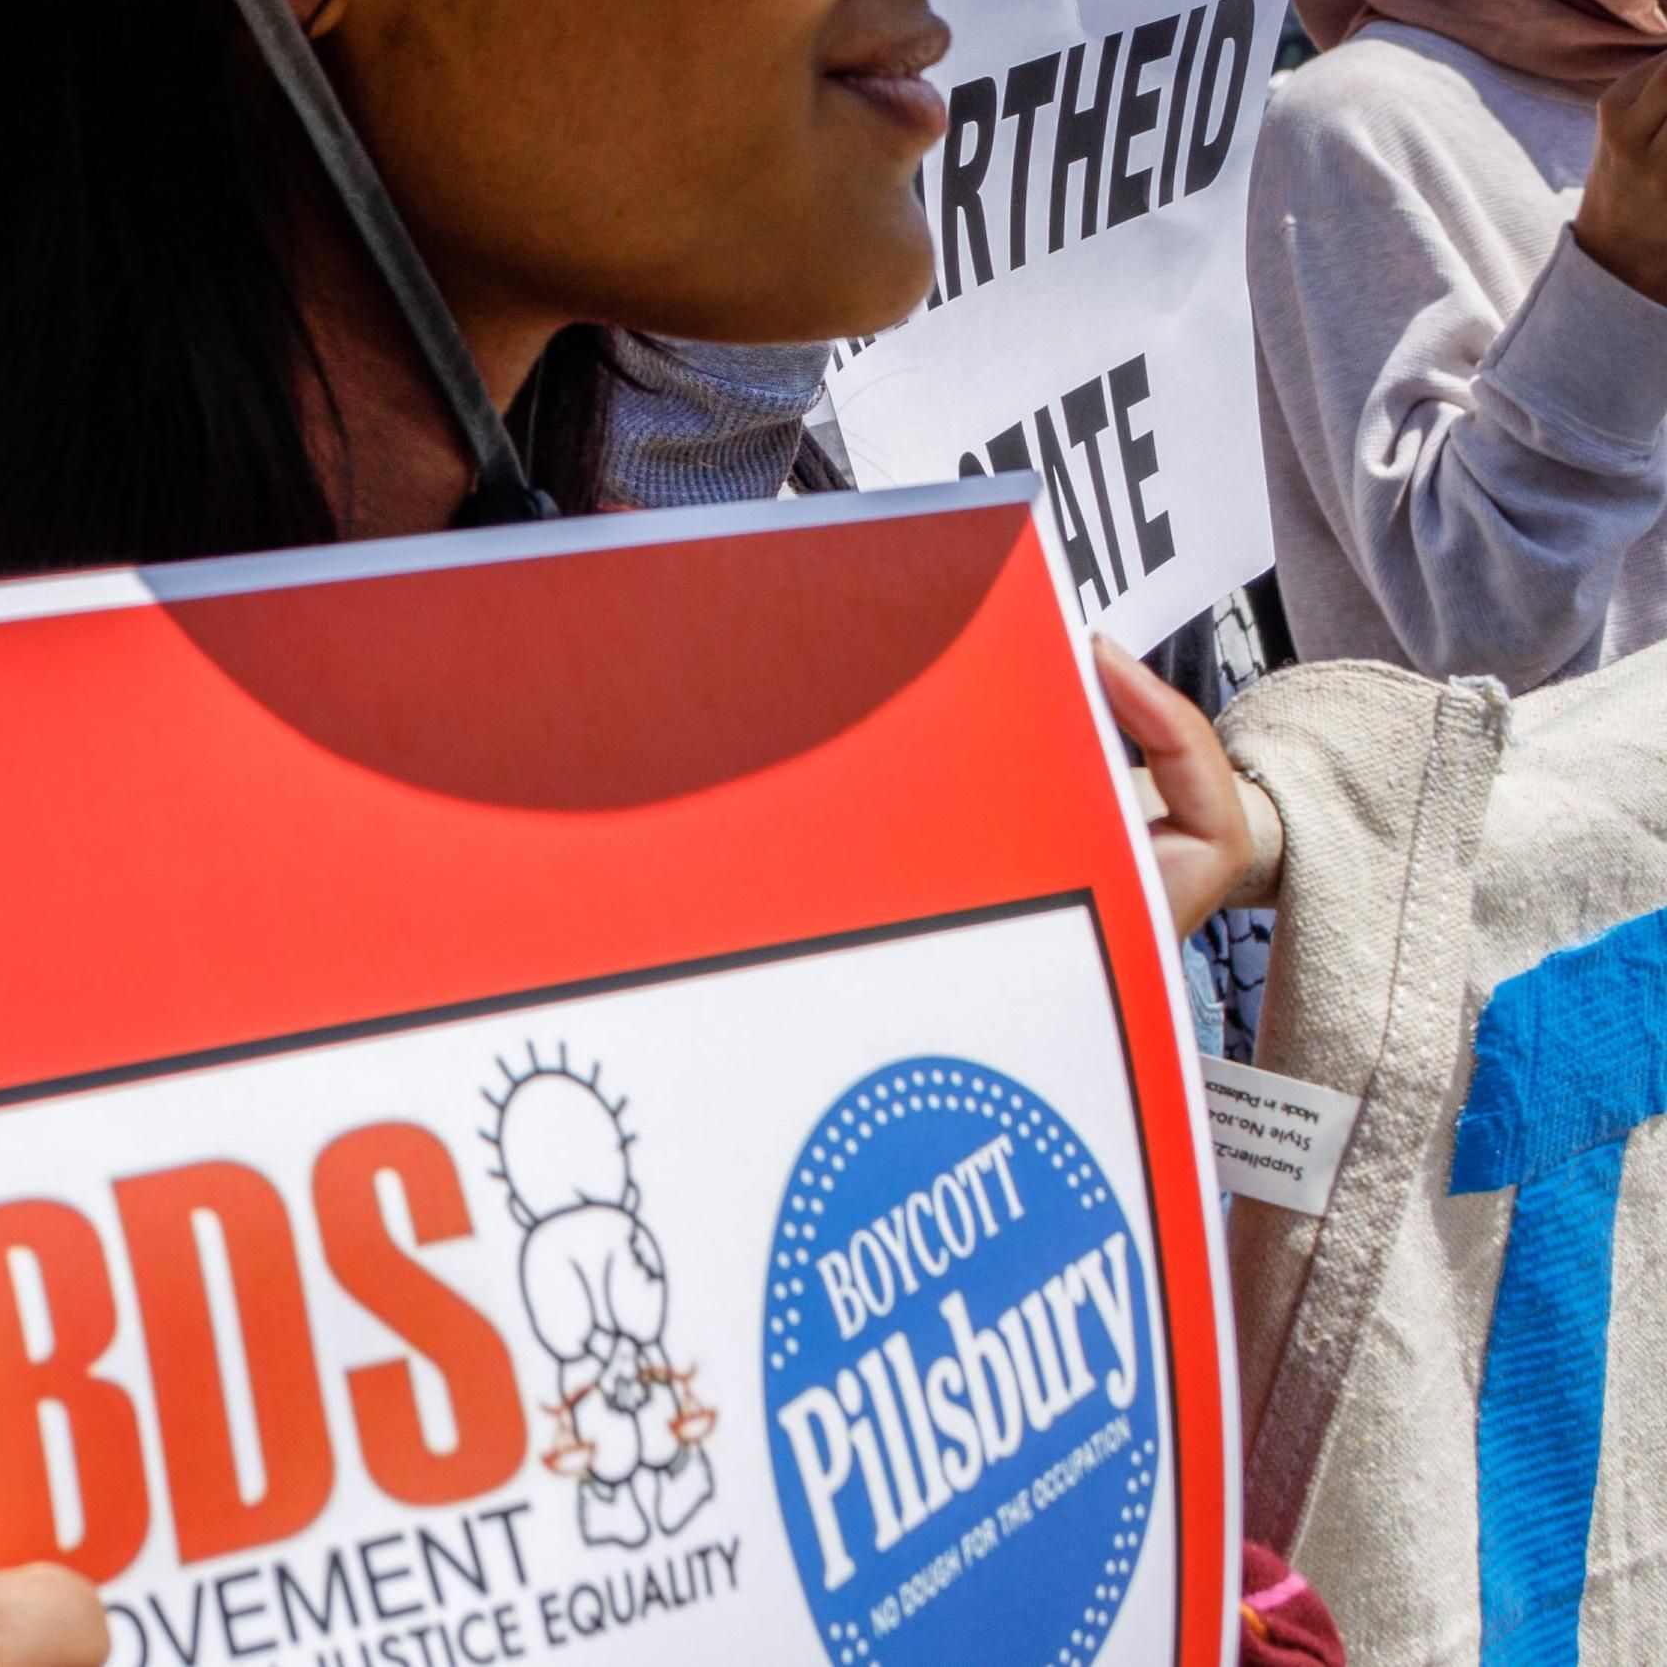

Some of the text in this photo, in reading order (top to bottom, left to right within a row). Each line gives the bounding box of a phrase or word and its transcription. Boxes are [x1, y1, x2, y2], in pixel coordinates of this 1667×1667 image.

[959, 352, 1175, 625] ATE
[1270, 1126, 1312, 1151] Style
[1280, 1102, 1319, 1125] Made
[815, 1133, 1025, 1341] BOYCOTT
[778, 1232, 1138, 1592] Pillsbury
[104, 1501, 533, 1667] VEMENT
[538, 1537, 741, 1647] EQUALITY
[871, 1412, 1132, 1639] NO DOUGH FOR THE OCCUPATION
